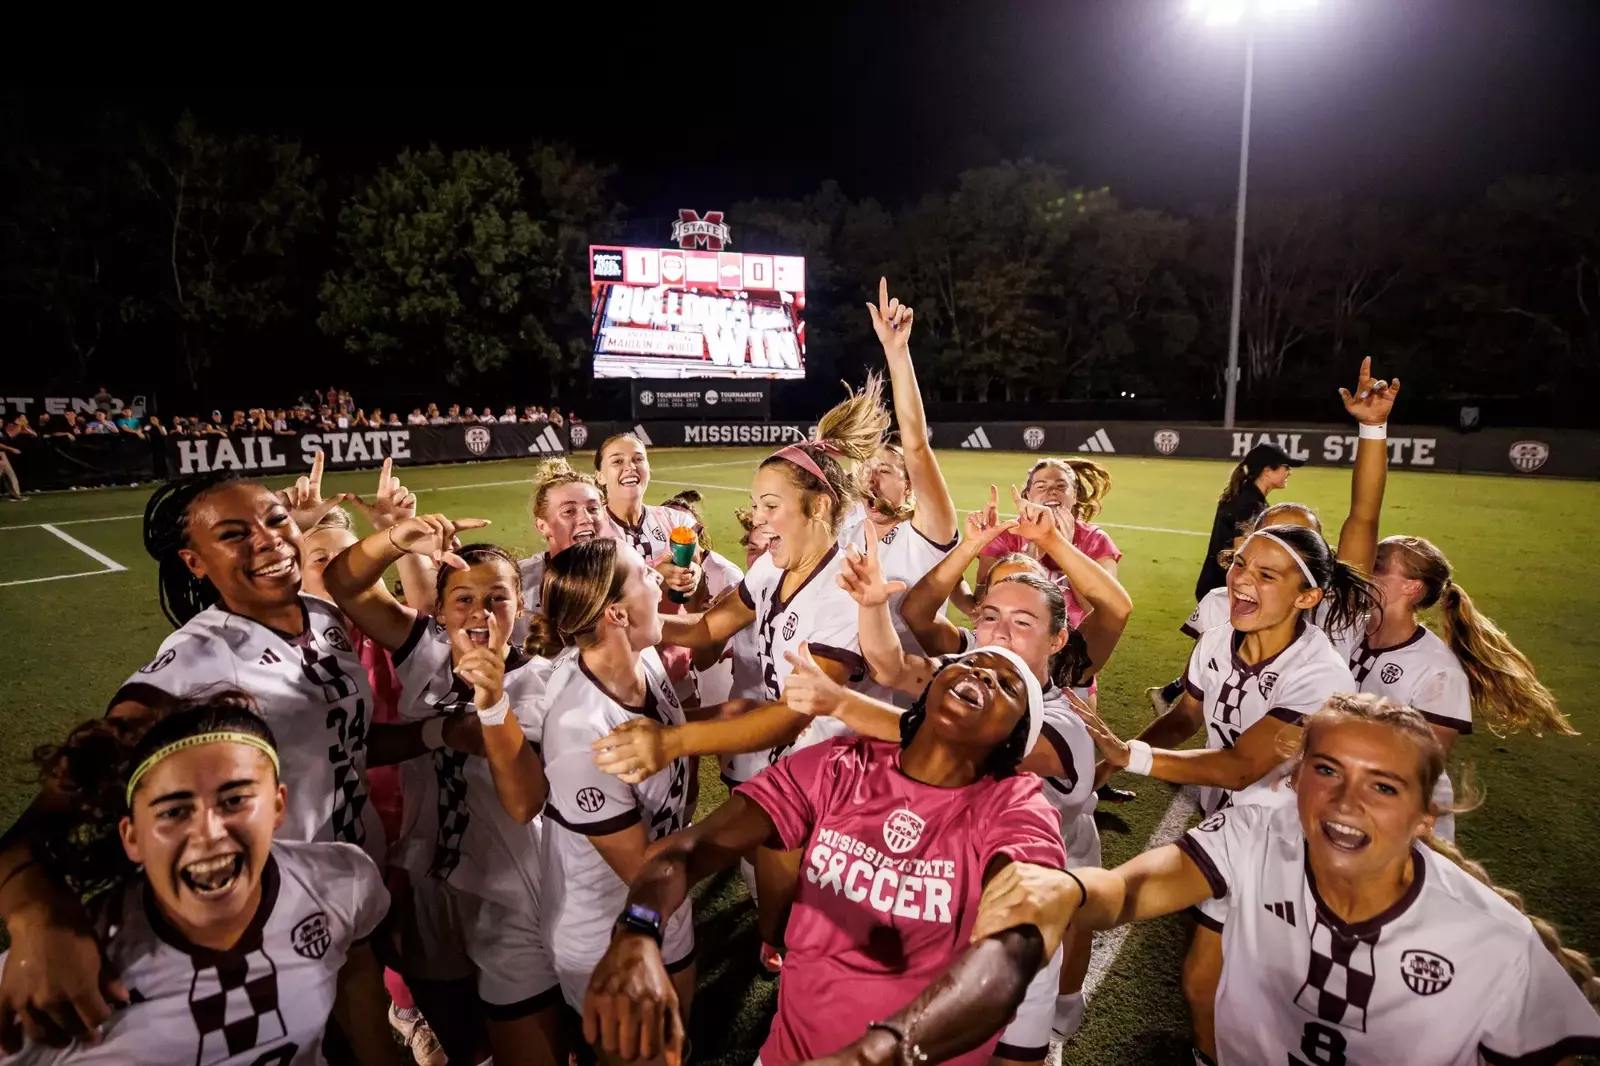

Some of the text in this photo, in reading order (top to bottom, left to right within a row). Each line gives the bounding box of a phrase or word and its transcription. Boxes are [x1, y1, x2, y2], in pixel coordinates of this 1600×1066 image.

[683, 222, 720, 236] STATE
[703, 325, 801, 369] WIN
[0, 397, 34, 414] T
[656, 391, 700, 399] TOURNAMENTS
[720, 391, 763, 399] TOURNAMENTS
[684, 425, 800, 443] MISSISSIPPI
[177, 430, 411, 474] HAIL STATE
[1323, 435, 1436, 465] STTE
[326, 698, 365, 764] 34
[577, 787, 605, 812] SEC
[817, 828, 908, 872] MISISSIPI
[1301, 1022, 1347, 1066] 8
